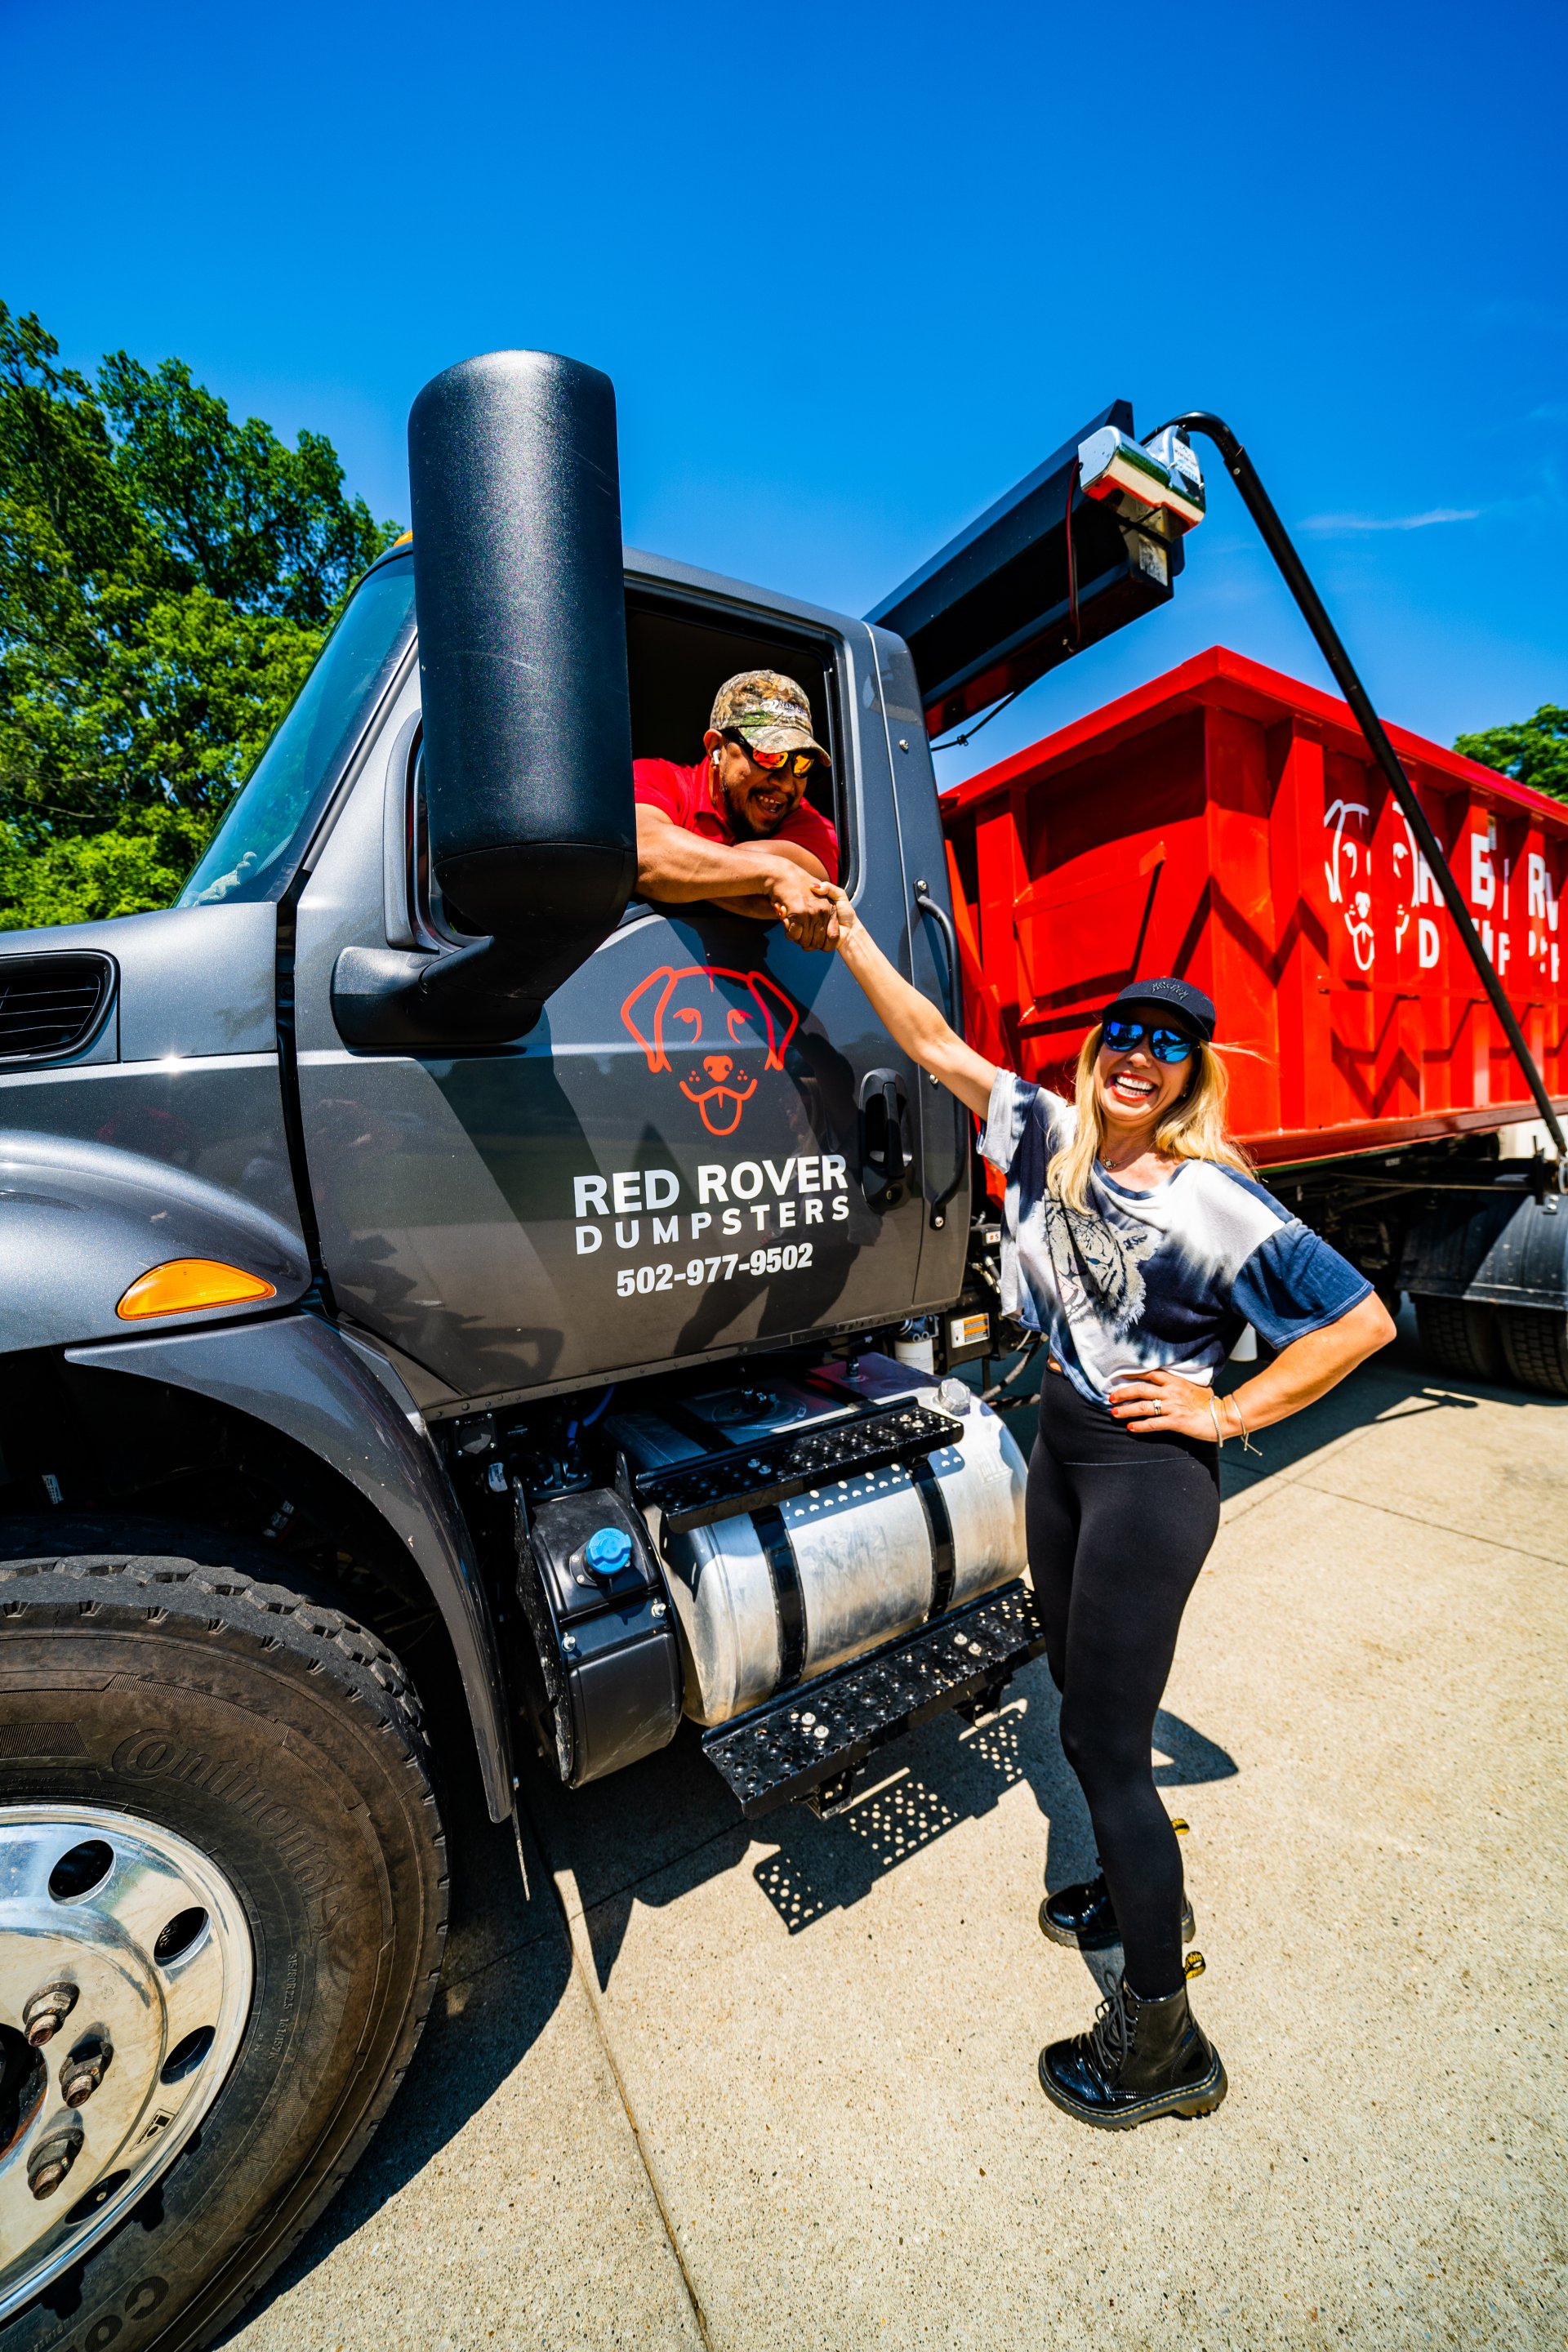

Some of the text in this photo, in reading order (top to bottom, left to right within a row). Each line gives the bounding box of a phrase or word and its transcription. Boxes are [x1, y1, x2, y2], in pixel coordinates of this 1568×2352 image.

[573, 1154, 849, 1218] RED ROVER
[575, 1195, 849, 1255] DUMPSTERS
[617, 1242, 813, 1297] 502-977-9502
[111, 1728, 348, 1907] Continental
[283, 1953, 298, 2011] 315/80R22.5
